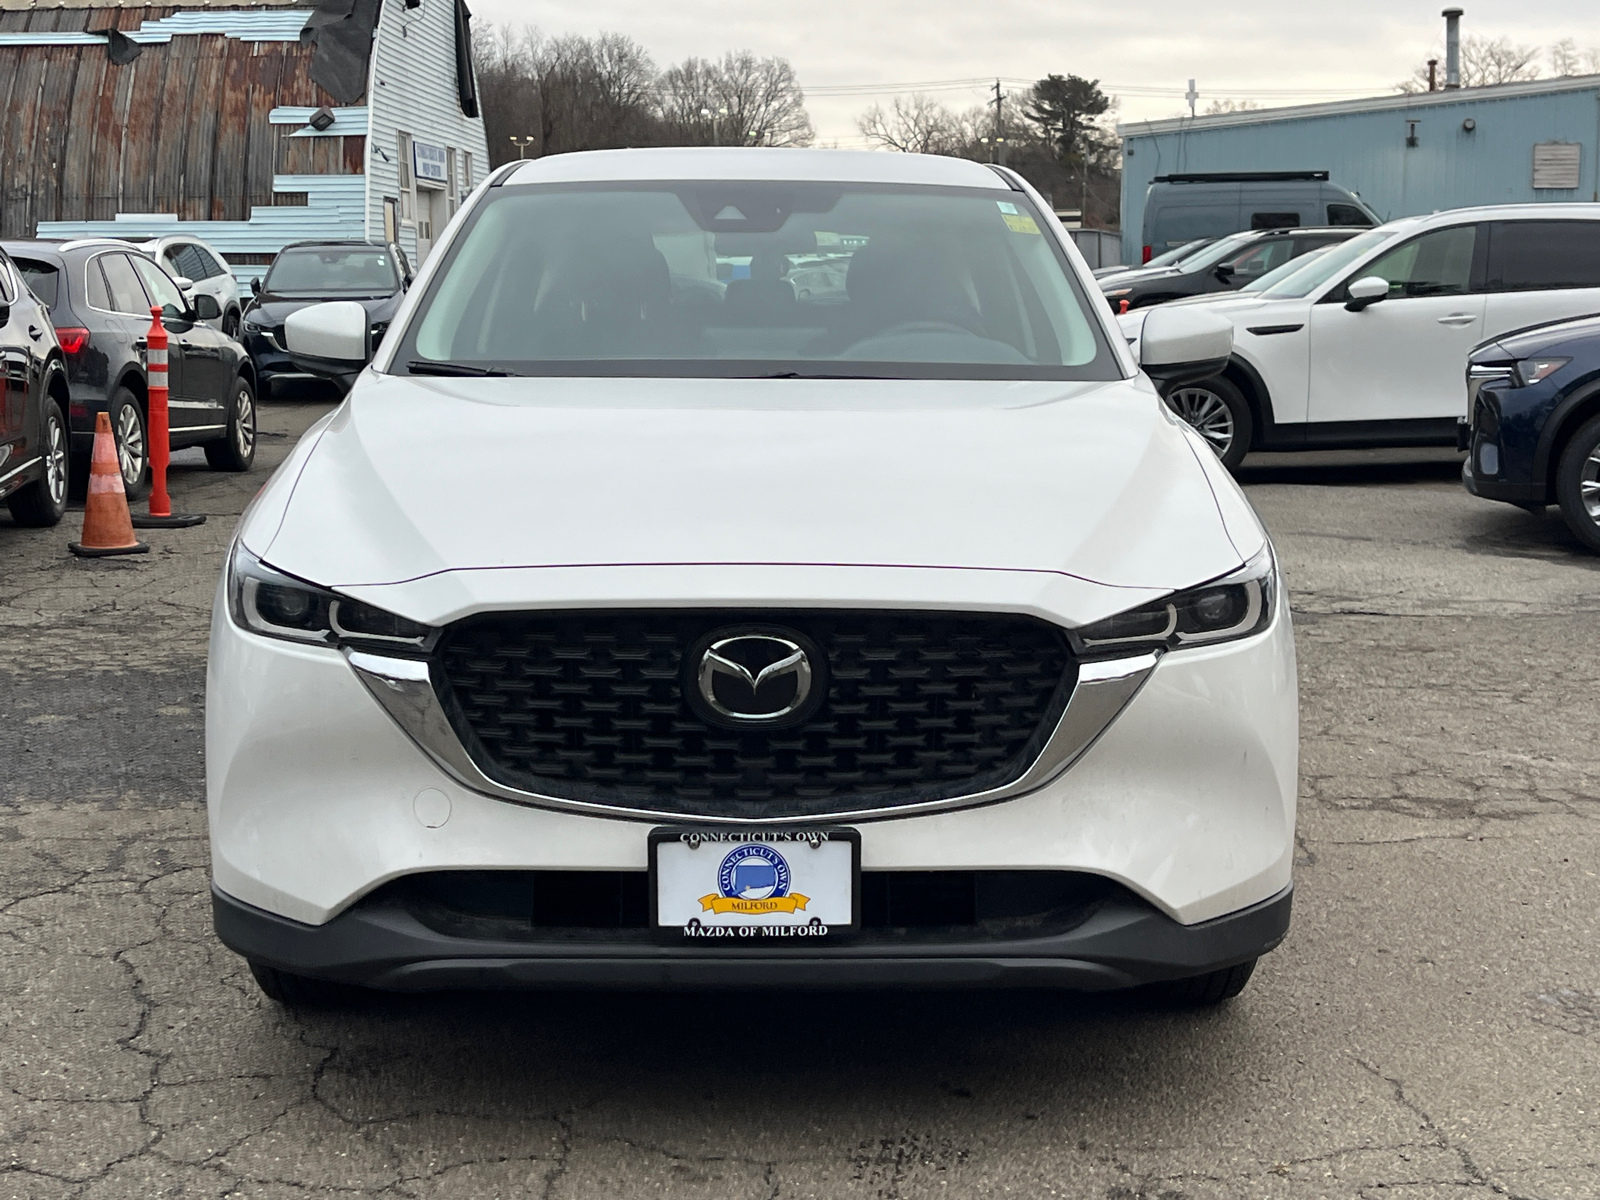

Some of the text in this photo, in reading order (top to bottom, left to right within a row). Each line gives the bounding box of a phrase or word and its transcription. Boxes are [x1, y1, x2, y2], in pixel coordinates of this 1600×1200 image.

[680, 832, 829, 842] CONNECTICUT'S OWN
[777, 864, 788, 890] OWN
[731, 901, 778, 911] MILFORD
[683, 926, 828, 937] MAZDA OF MILFORD
